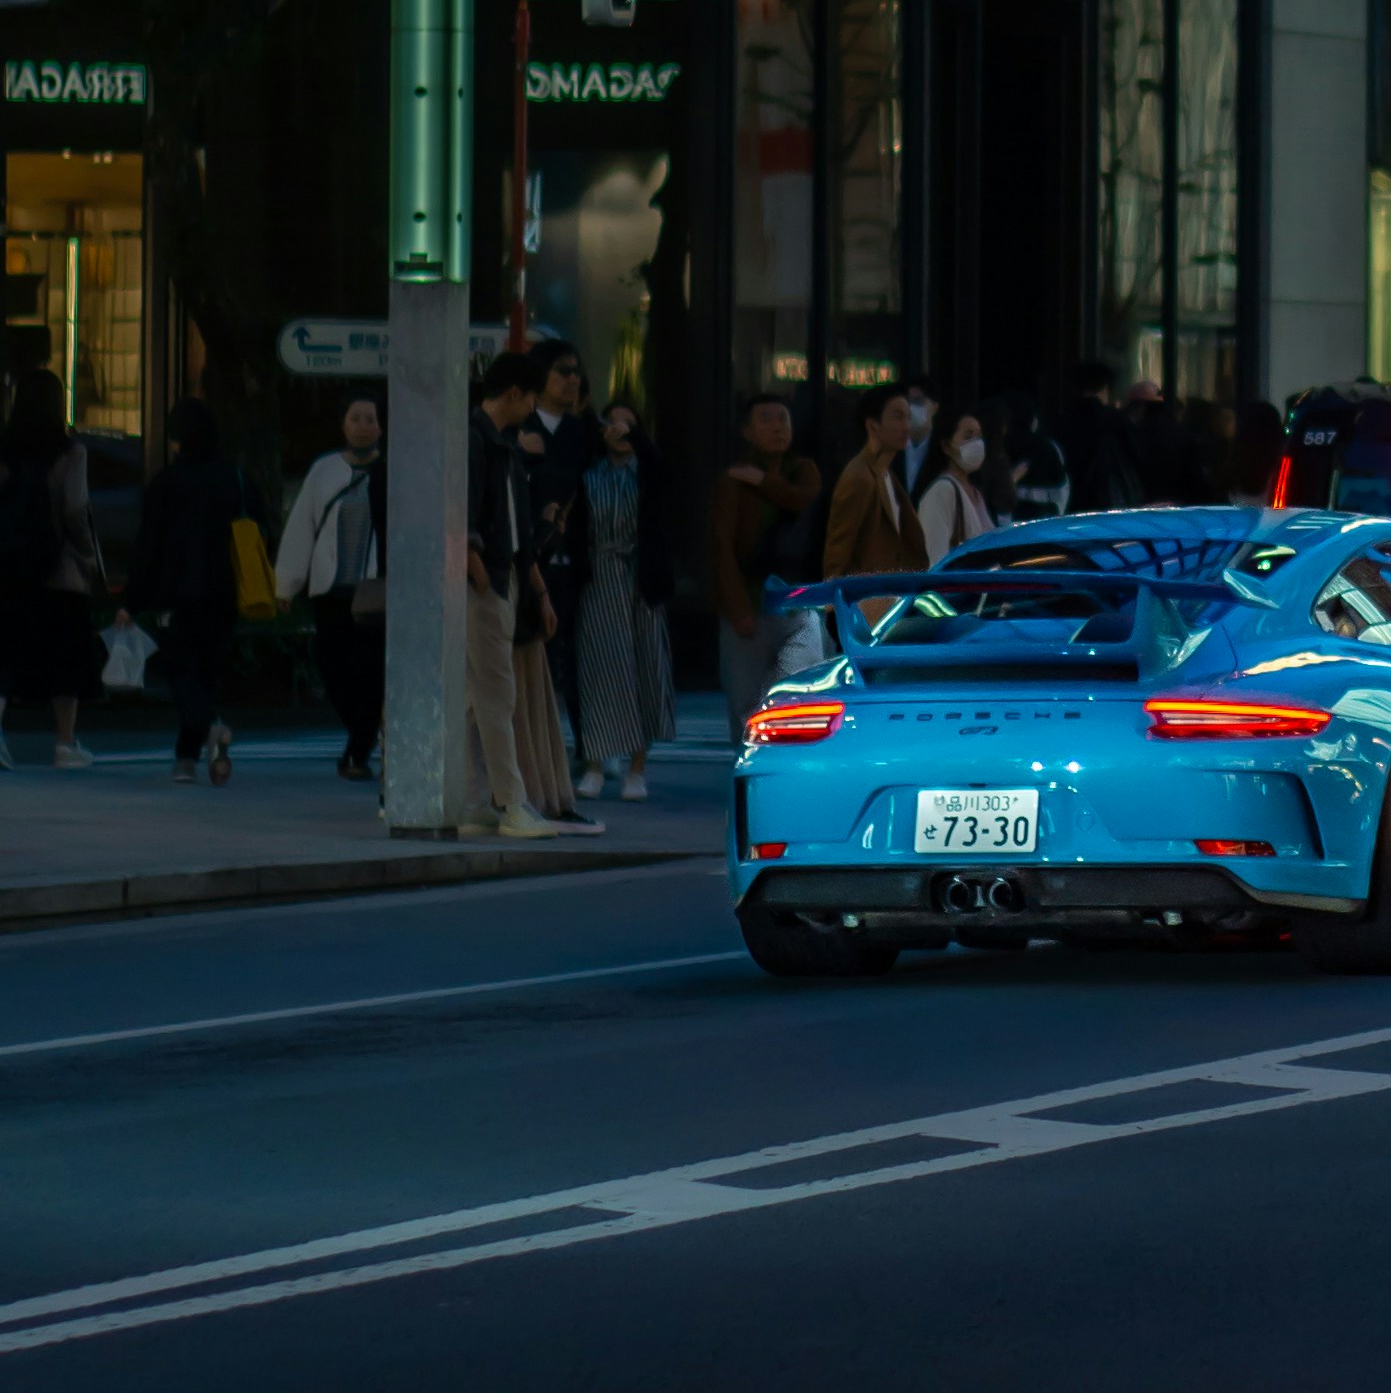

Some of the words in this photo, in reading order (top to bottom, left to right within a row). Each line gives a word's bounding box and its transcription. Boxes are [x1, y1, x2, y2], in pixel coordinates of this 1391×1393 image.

[888, 711, 1082, 722] PORSCHE
[923, 823, 938, 840] せ
[943, 815, 1030, 848] 73-30
